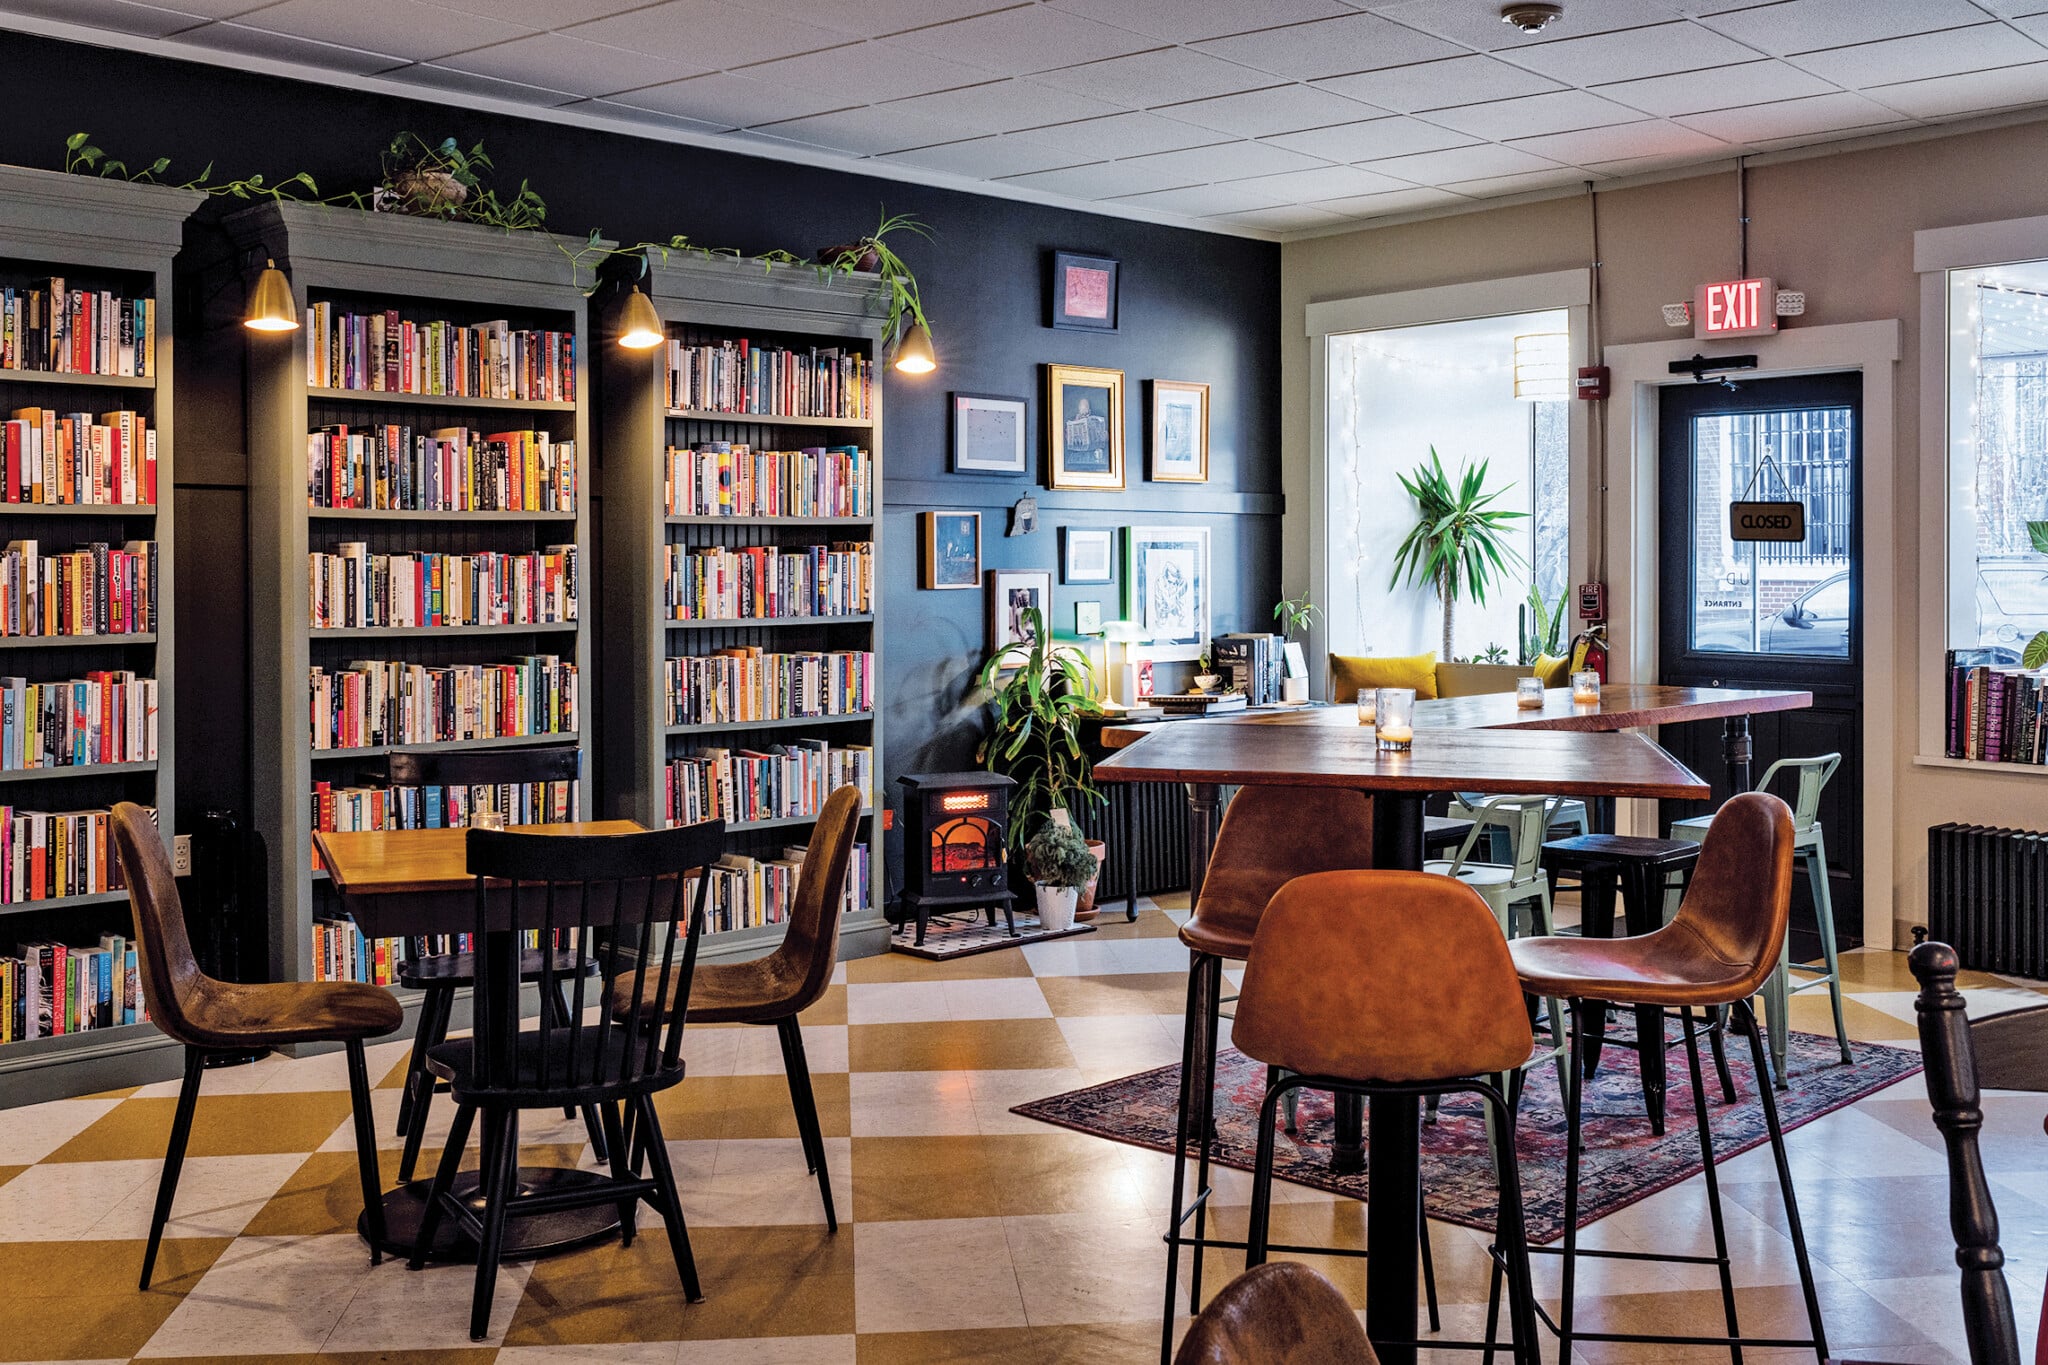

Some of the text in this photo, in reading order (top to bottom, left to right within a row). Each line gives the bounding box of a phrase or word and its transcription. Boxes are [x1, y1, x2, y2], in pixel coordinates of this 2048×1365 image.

[1707, 282, 1762, 331] EXIT
[1741, 514, 1792, 529] CLOSED
[1581, 585, 1599, 594] FIRE
[4, 703, 12, 725] SOLO
[1970, 700, 1978, 743] ARTILLERY
[1988, 675, 2001, 739] The House Book
